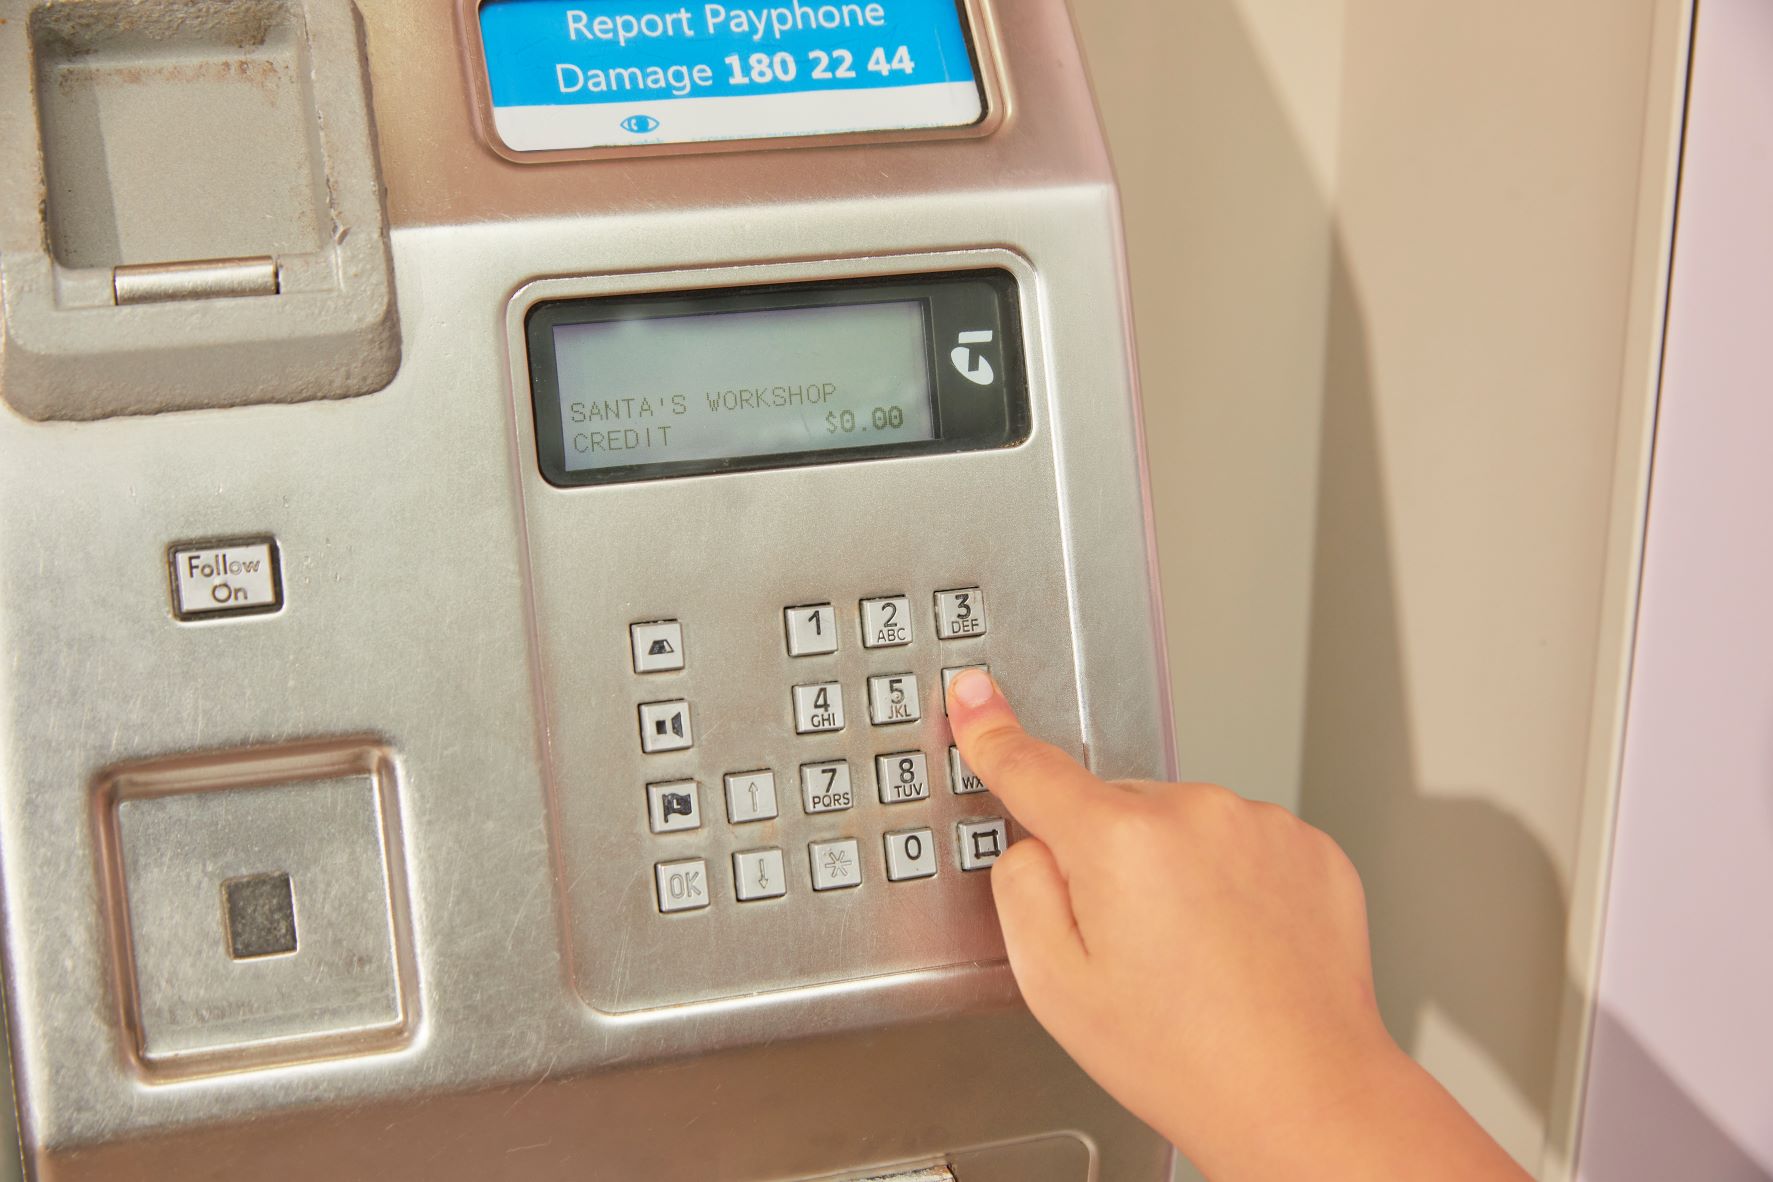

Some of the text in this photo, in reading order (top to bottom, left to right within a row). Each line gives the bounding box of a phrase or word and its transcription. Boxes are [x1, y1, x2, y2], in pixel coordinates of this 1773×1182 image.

[567, 0, 885, 45] Report Payphone
[556, 45, 915, 95] Damage 180 22 44
[570, 383, 836, 424] SANTA'S WORKSHOP
[574, 406, 904, 452] CREDIT $0.00
[188, 553, 261, 578] Follow
[212, 583, 248, 603] On
[881, 603, 897, 628] 2
[954, 593, 972, 619] 3
[807, 610, 821, 636] 1
[877, 628, 906, 643] ABC
[951, 619, 979, 634] DEF
[813, 687, 830, 712] 4
[889, 679, 905, 703] 5
[811, 714, 836, 728] GHI
[887, 705, 911, 720] JKL
[821, 768, 837, 793] 7
[899, 758, 915, 783] 8
[962, 775, 984, 790] WX
[812, 793, 850, 808] PQRS
[893, 783, 923, 799] TUV
[670, 871, 702, 900] OK
